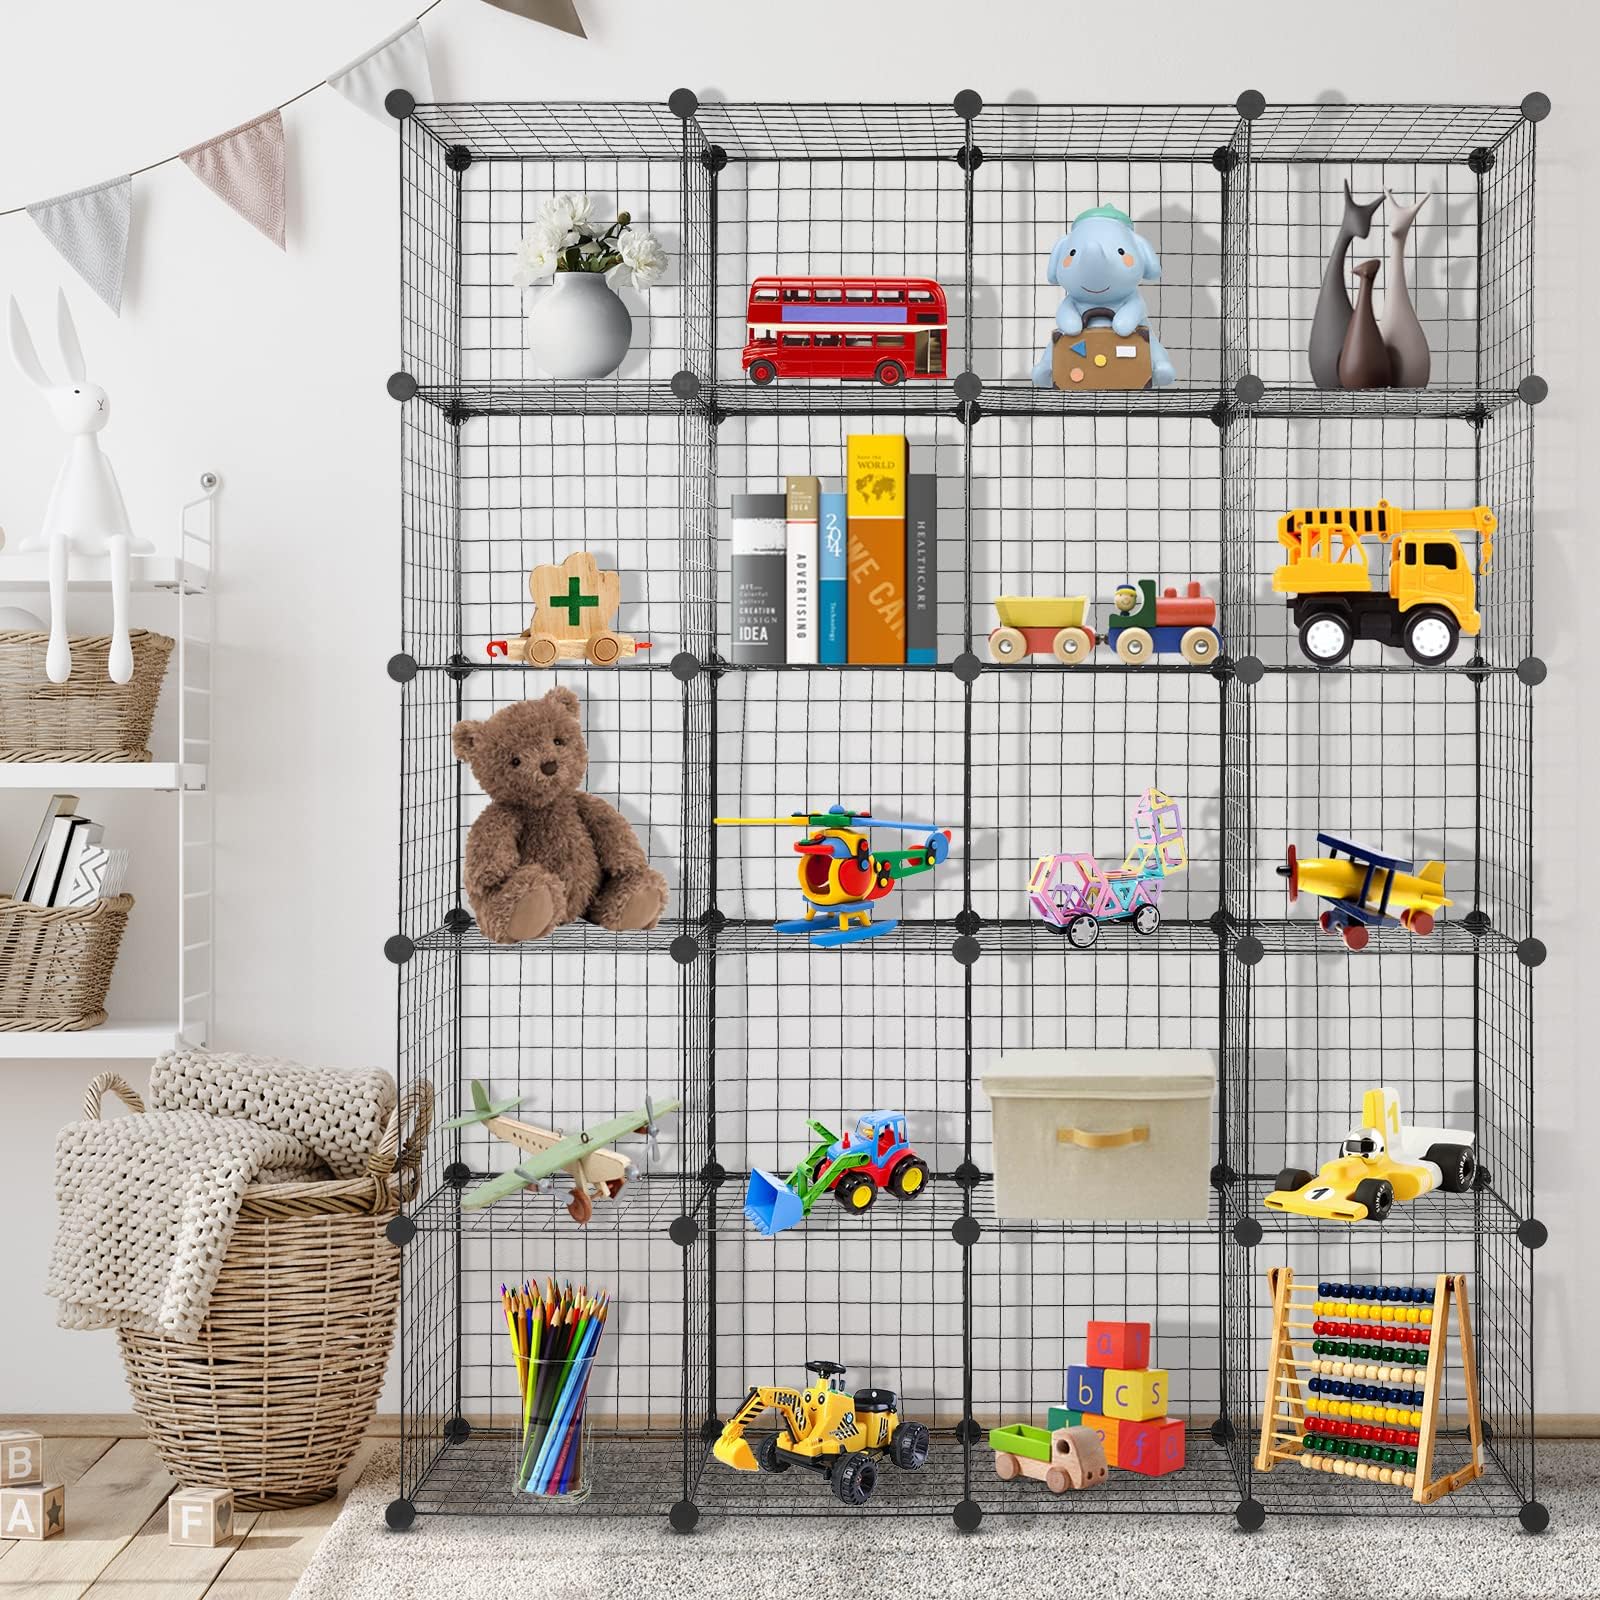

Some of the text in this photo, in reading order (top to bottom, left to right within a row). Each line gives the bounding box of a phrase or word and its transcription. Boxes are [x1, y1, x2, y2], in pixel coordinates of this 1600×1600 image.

[858, 461, 896, 470] WORLD
[848, 534, 880, 584] WE
[917, 521, 926, 610] HEALTHCARE
[740, 607, 776, 615] CREATION
[796, 554, 807, 639] ADVERTISING
[739, 626, 769, 641] IDEA
[740, 616, 778, 624] DESIGN
[1387, 1102, 1399, 1134] 1
[1311, 1188, 1330, 1200] 1
[1097, 1333, 1113, 1355] a
[1079, 1374, 1093, 1405] b
[8, 1446, 32, 1479] B
[1131, 1431, 1148, 1466] f
[6, 1498, 35, 1533] A
[181, 1505, 203, 1539] F
